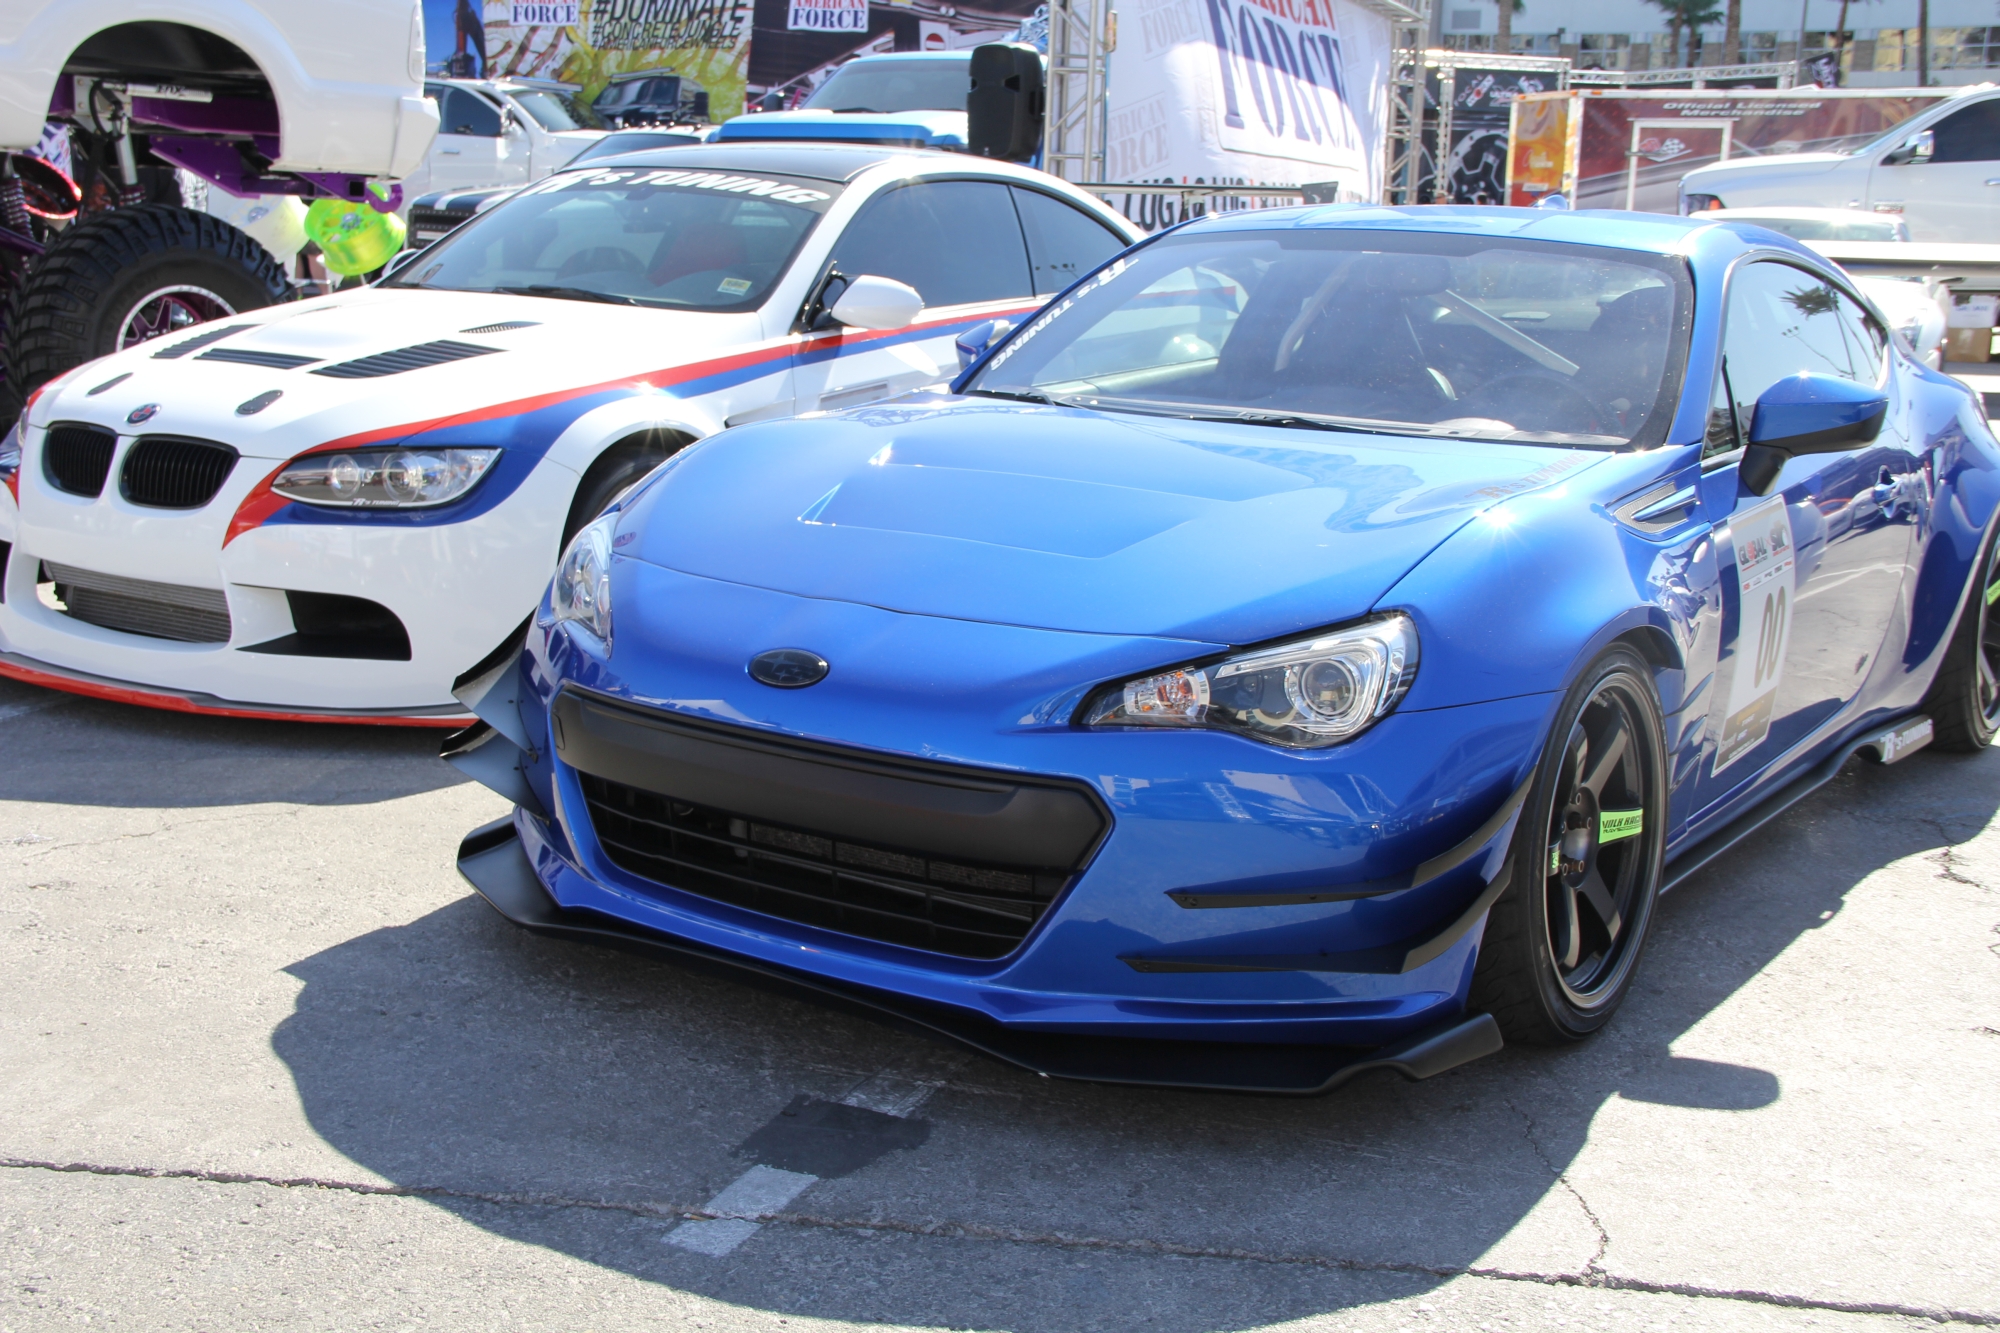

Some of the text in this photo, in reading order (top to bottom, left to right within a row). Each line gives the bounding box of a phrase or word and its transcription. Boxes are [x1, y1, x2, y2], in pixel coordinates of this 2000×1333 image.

[513, 5, 577, 24] FORCE
[593, 0, 748, 24] #DOMINATE
[791, 8, 865, 29] FORCE
[1206, 0, 1355, 151] FORCE
[1663, 102, 1731, 110] Official
[1680, 109, 1806, 117] Merchandise
[1106, 124, 1169, 182] ORCE
[626, 170, 832, 205] TUNING
[990, 299, 1074, 371] TUNING
[1519, 452, 1589, 485] TUNING
